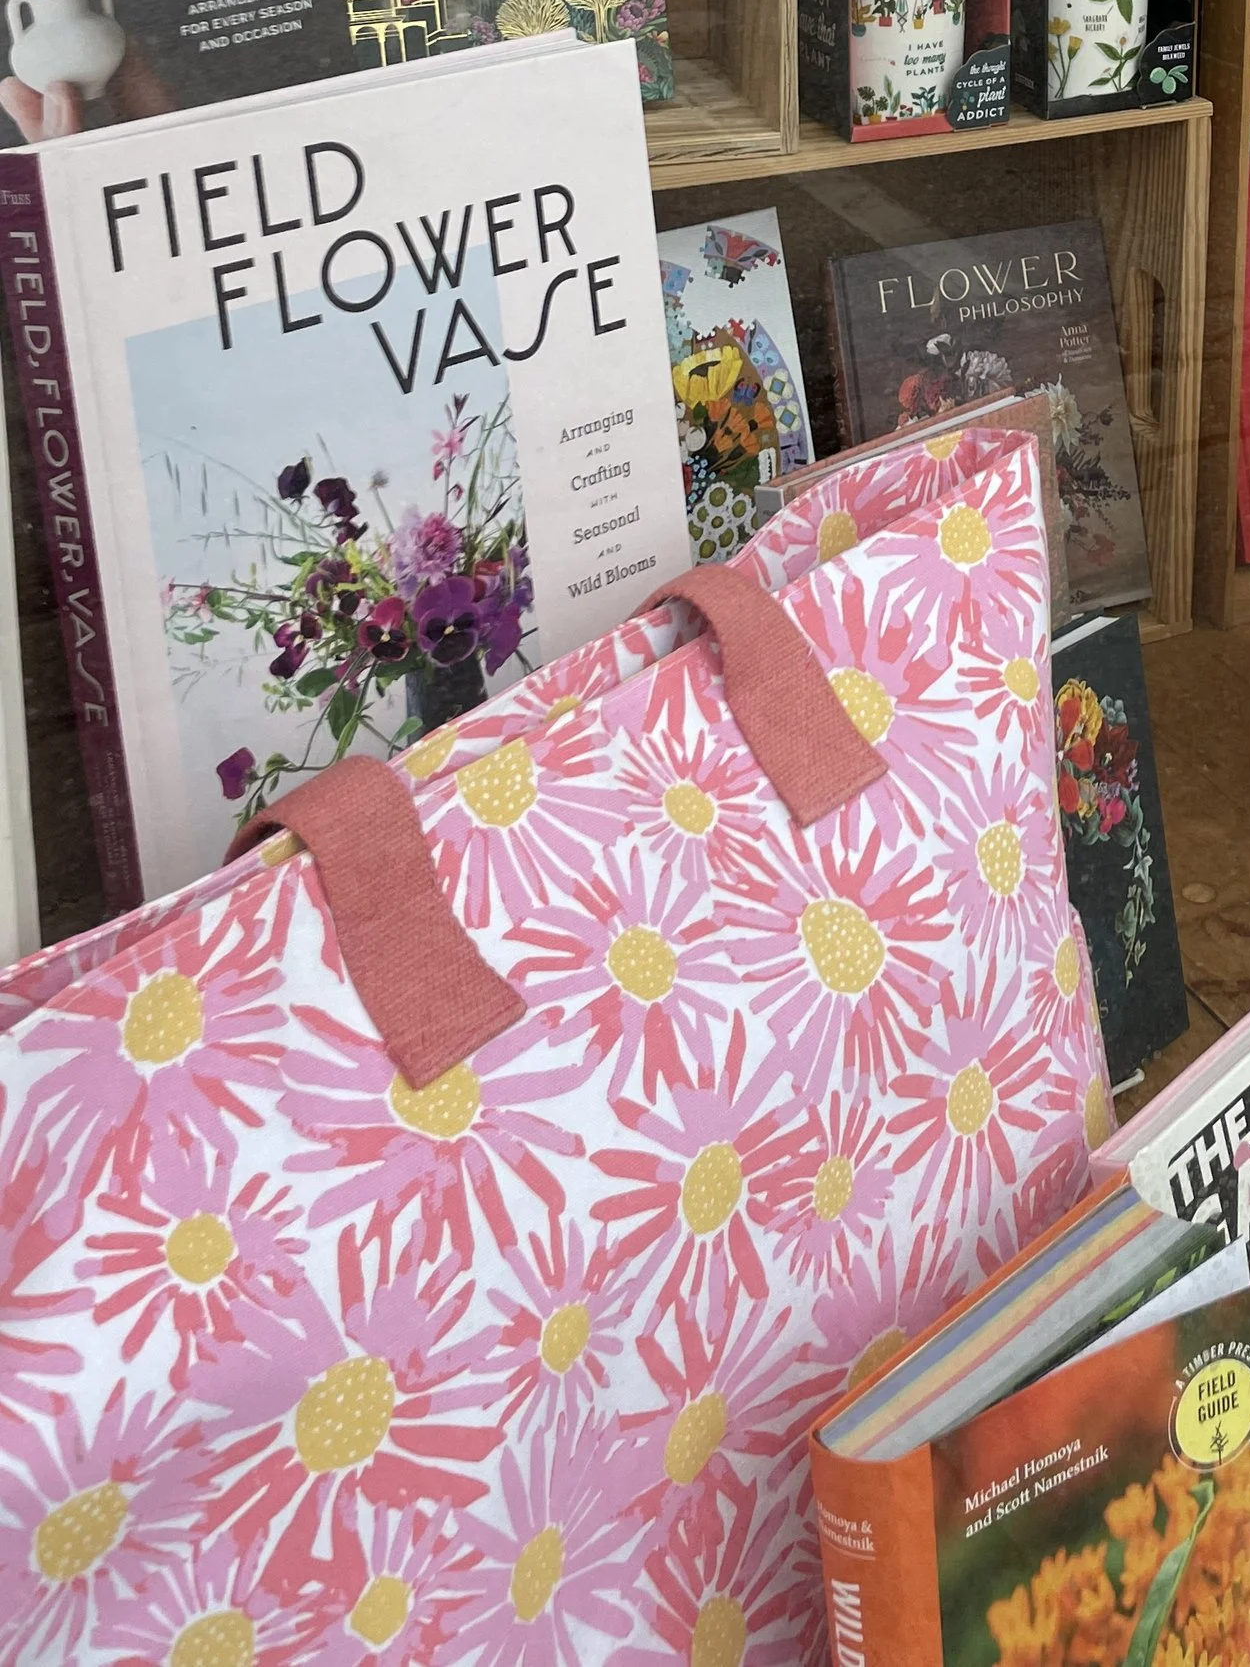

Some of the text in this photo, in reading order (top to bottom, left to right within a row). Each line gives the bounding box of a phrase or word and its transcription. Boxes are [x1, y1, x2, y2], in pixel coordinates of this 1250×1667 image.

[180, 21, 210, 36] FOR
[211, 11, 257, 30] EVERY
[199, 19, 303, 52] AND OCCASION
[103, 141, 365, 273] FIELD
[214, 184, 577, 350] FLOWER
[878, 250, 1083, 313] FLOWER
[371, 254, 627, 395] VASE
[959, 287, 1084, 323] PHILOSOPHY
[559, 408, 634, 445] Arranging
[586, 443, 611, 458] AND
[570, 461, 631, 492] Crafting
[573, 505, 641, 545] Seasonal
[568, 555, 657, 599] Wild Blooms
[1174, 1377, 1186, 1391] A
[1182, 1343, 1225, 1381] TIMBER
[1197, 1368, 1236, 1401] FIELD
[1197, 1389, 1240, 1425] GUIDE
[963, 1437, 1083, 1515] Michael Homoya
[964, 1444, 1110, 1538] and Scott Namestnik
[830, 1579, 866, 1667] WILD
